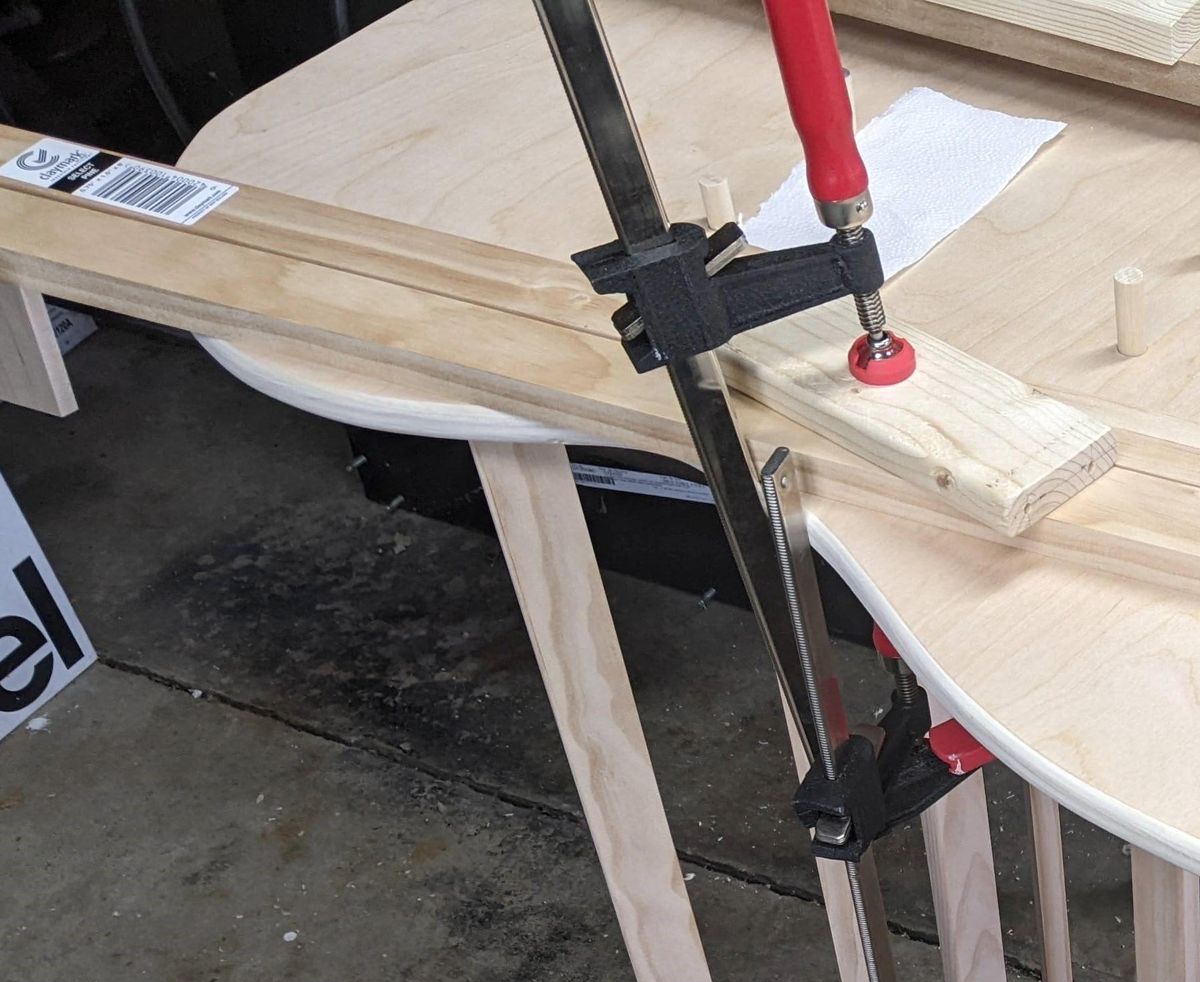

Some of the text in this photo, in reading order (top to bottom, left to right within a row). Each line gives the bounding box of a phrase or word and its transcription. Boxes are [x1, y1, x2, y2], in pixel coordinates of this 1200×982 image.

[40, 150, 81, 181] claymark
[67, 162, 95, 181] SELECT
[81, 168, 100, 180] PINE
